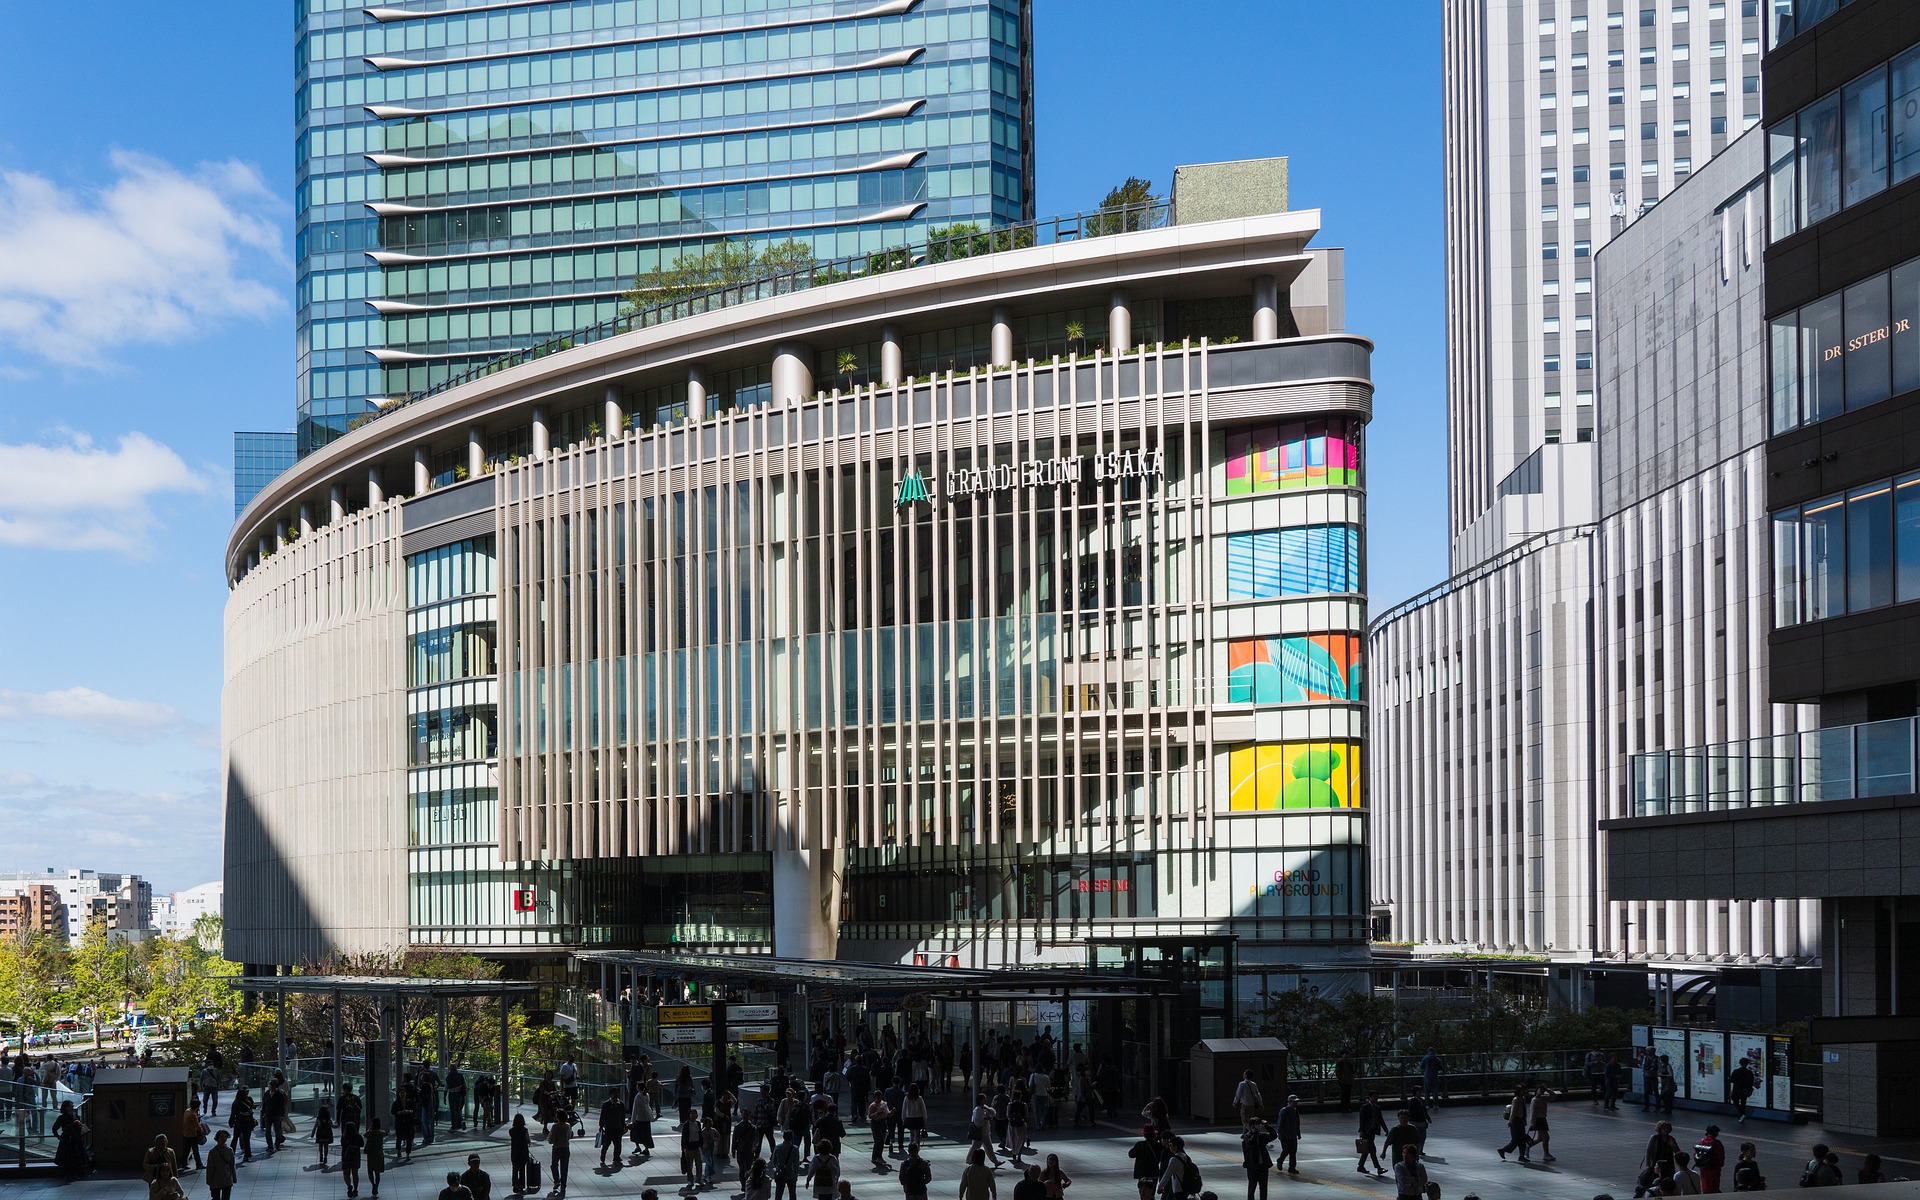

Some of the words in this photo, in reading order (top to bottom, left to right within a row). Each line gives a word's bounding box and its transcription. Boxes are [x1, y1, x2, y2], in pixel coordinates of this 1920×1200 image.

[1824, 319, 1910, 361] DRSSTERIR
[946, 463, 1011, 496] GRAND
[1021, 454, 1085, 488] FRONT
[1094, 446, 1163, 480] OSAKA
[1274, 869, 1320, 882] GRAND
[1249, 883, 1343, 897] PLAYGROUND!
[1040, 1011, 1088, 1022] KEYCA
